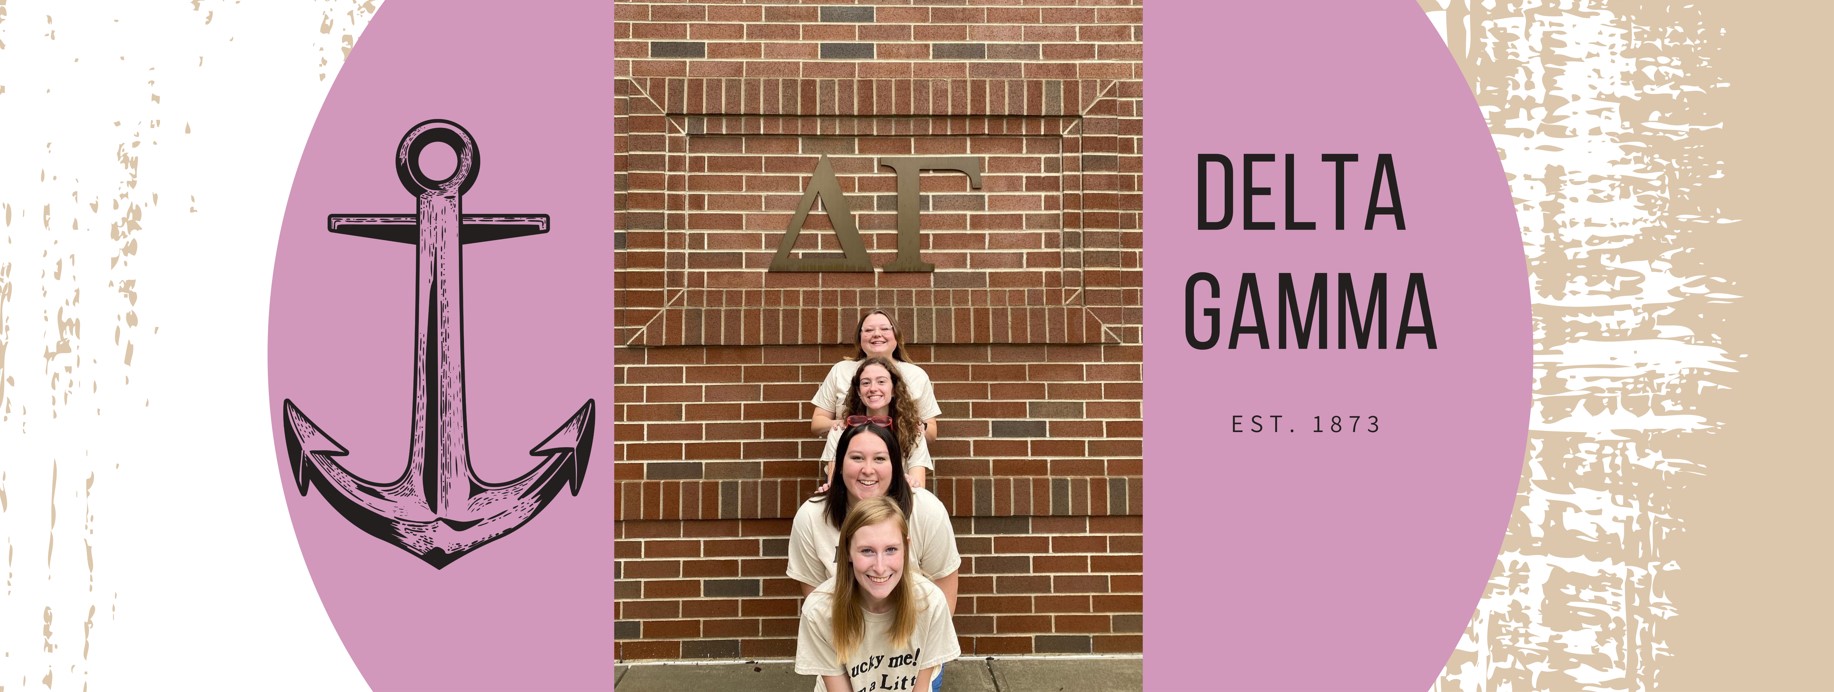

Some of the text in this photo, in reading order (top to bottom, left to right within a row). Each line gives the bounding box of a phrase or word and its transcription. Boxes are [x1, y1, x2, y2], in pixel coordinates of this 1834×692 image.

[850, 647, 921, 678] ucky me!
[880, 673, 917, 691] Litt
